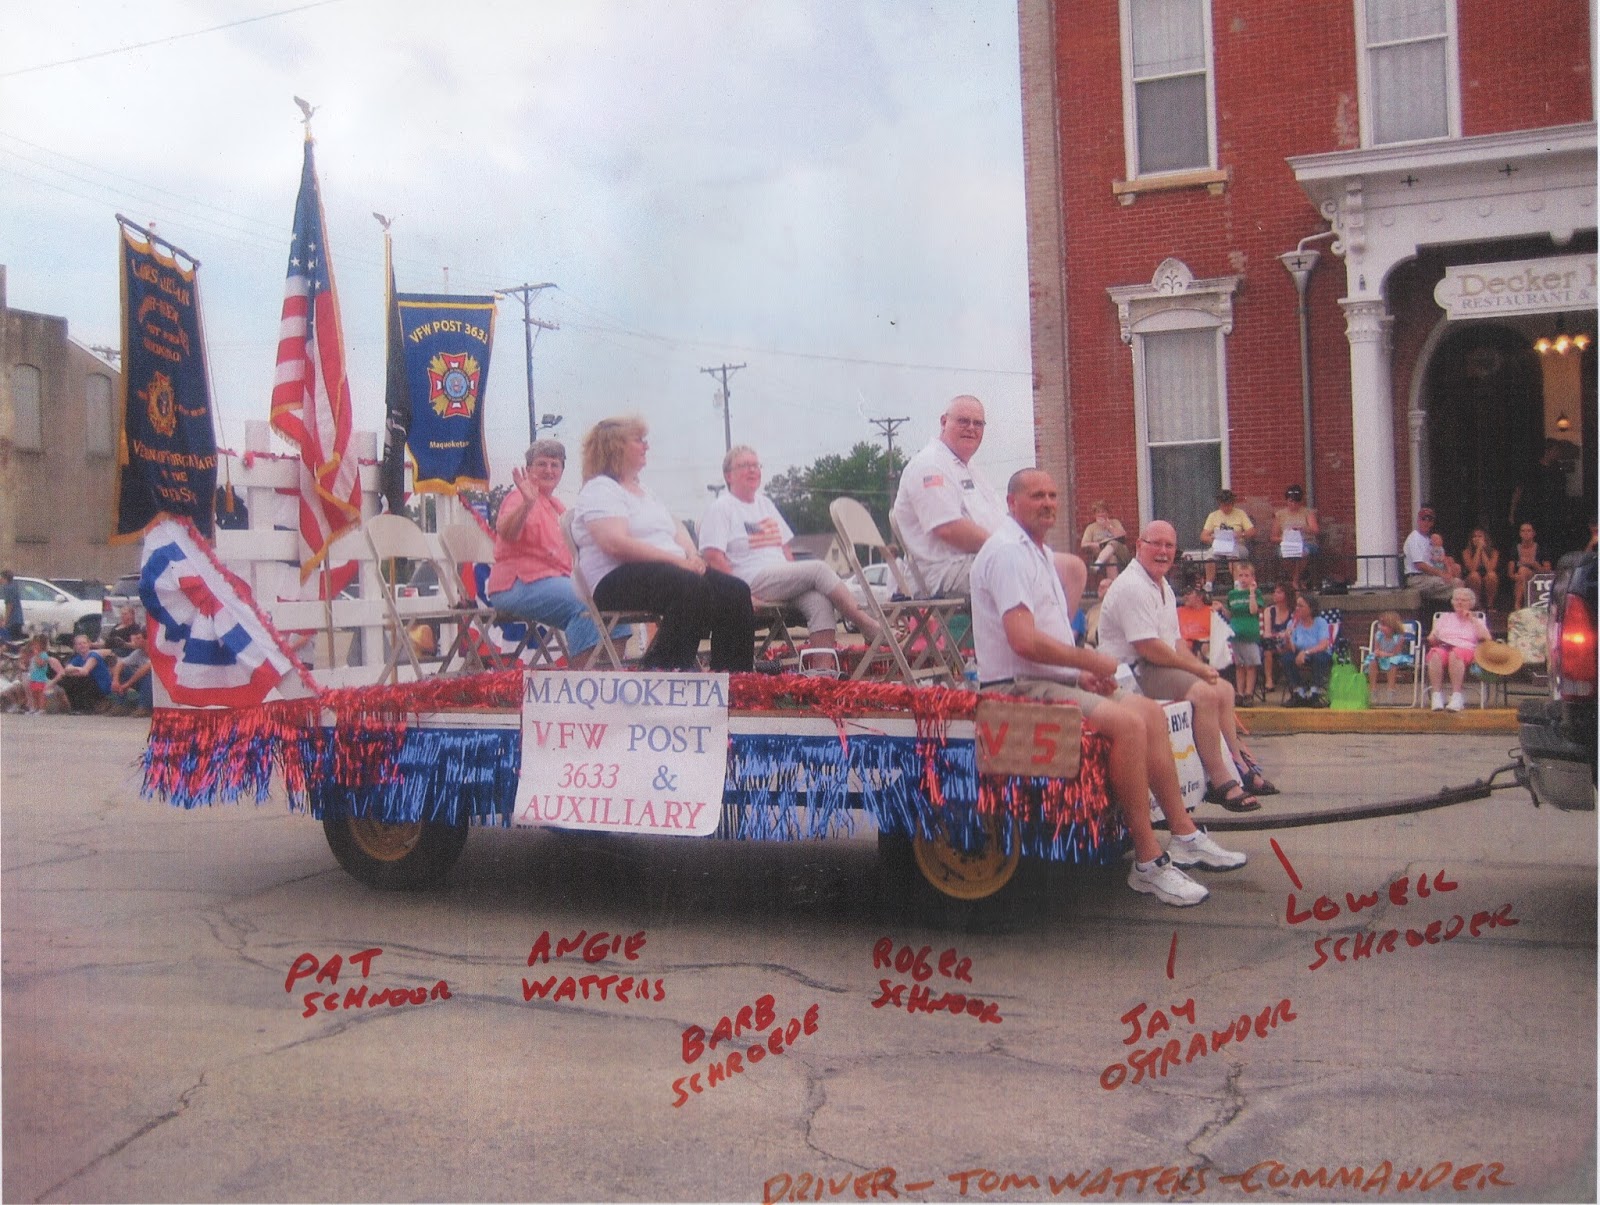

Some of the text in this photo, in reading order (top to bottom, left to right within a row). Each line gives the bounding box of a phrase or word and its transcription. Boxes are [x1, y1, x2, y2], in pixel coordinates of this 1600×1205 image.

[1457, 267, 1577, 297] Decker
[1462, 289, 1574, 309] RESTAURANT
[409, 323, 433, 343] VFW
[432, 319, 463, 334] POST
[525, 676, 729, 710] MAQUOKETA
[532, 720, 711, 754] VFW POST
[558, 763, 678, 791] 3633 &
[520, 794, 707, 830] AUXILIARY
